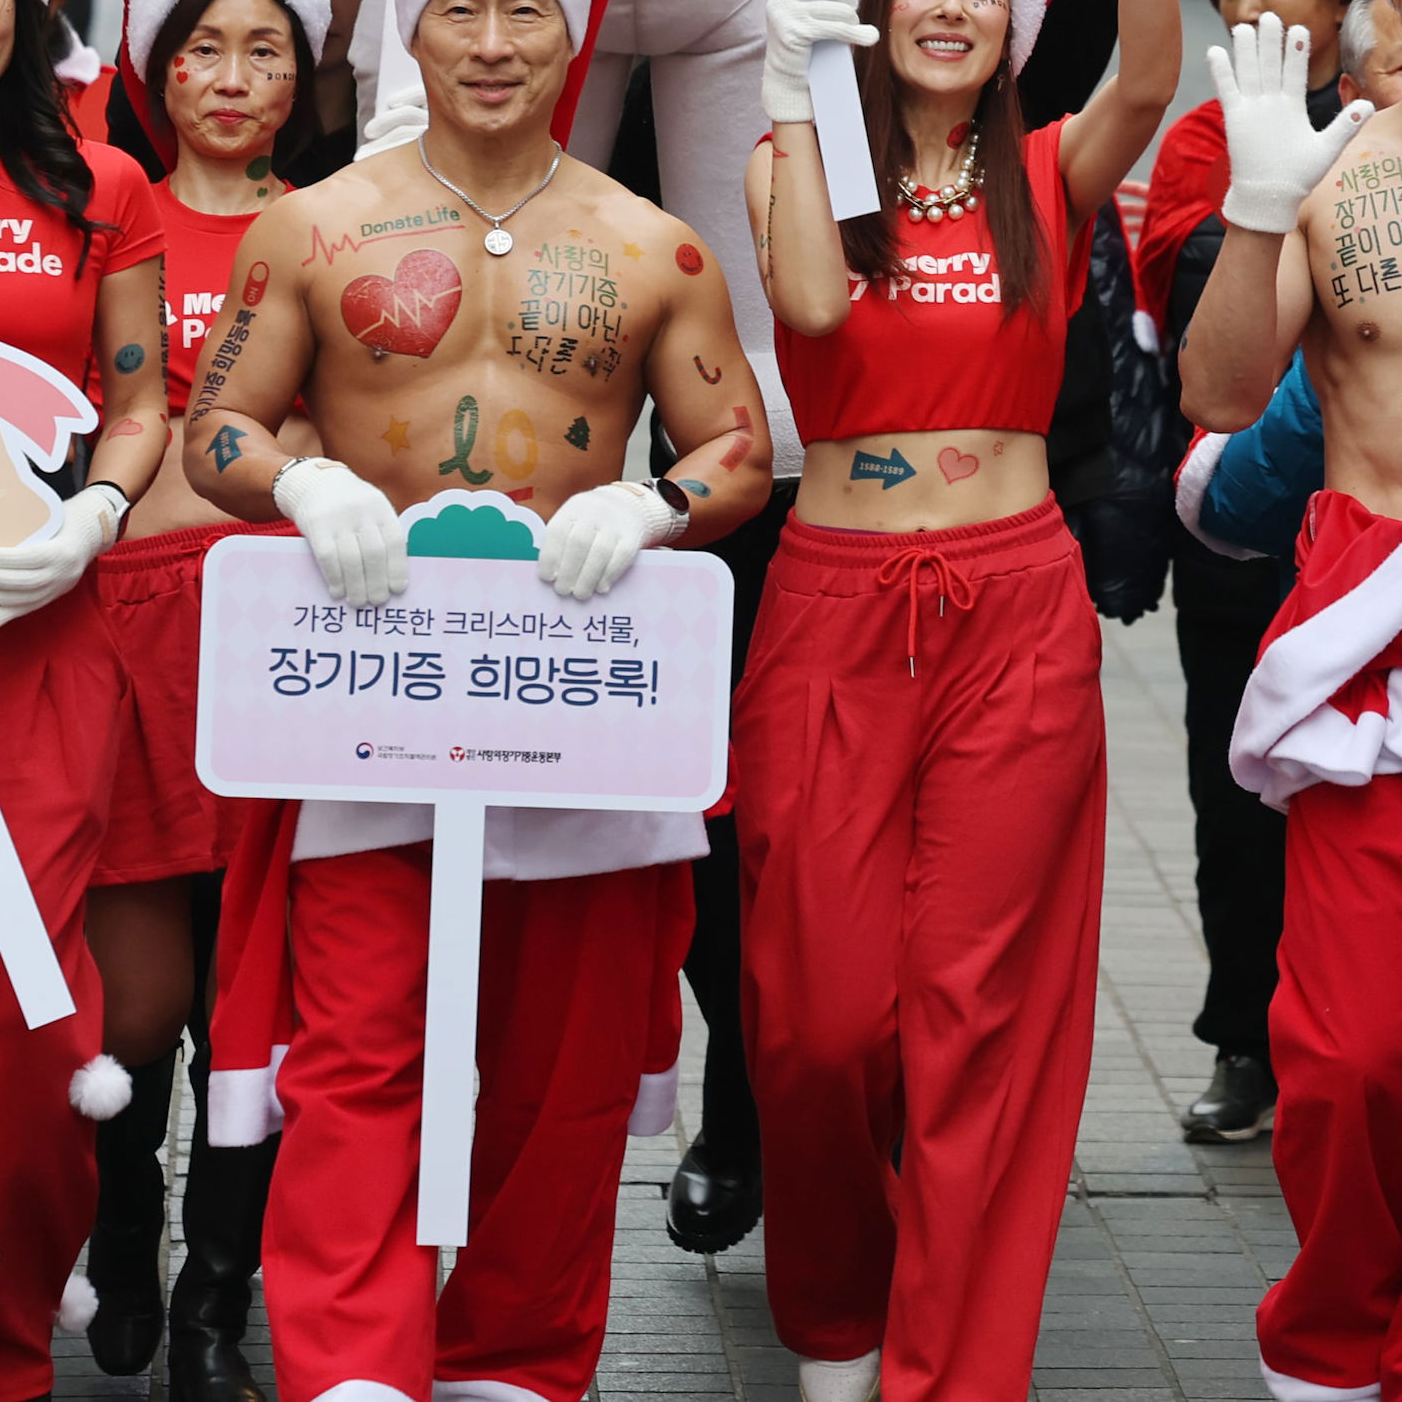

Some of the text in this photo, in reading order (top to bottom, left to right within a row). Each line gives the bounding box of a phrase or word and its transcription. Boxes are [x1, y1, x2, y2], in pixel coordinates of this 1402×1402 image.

[360, 204, 461, 238] Donate Life
[540, 243, 610, 277] 사랑의
[1336, 223, 1382, 269] 끝이
[527, 269, 619, 309] 장기기증
[1331, 273, 1354, 310] 또
[1356, 256, 1402, 296] 다른
[518, 299, 623, 345] 끝이 아닌
[858, 460, 906, 476] 1588-1589
[292, 604, 640, 647] 가장 따뜻한 크리스마스 선물,
[268, 647, 659, 708] 장기기증 희망등록!
